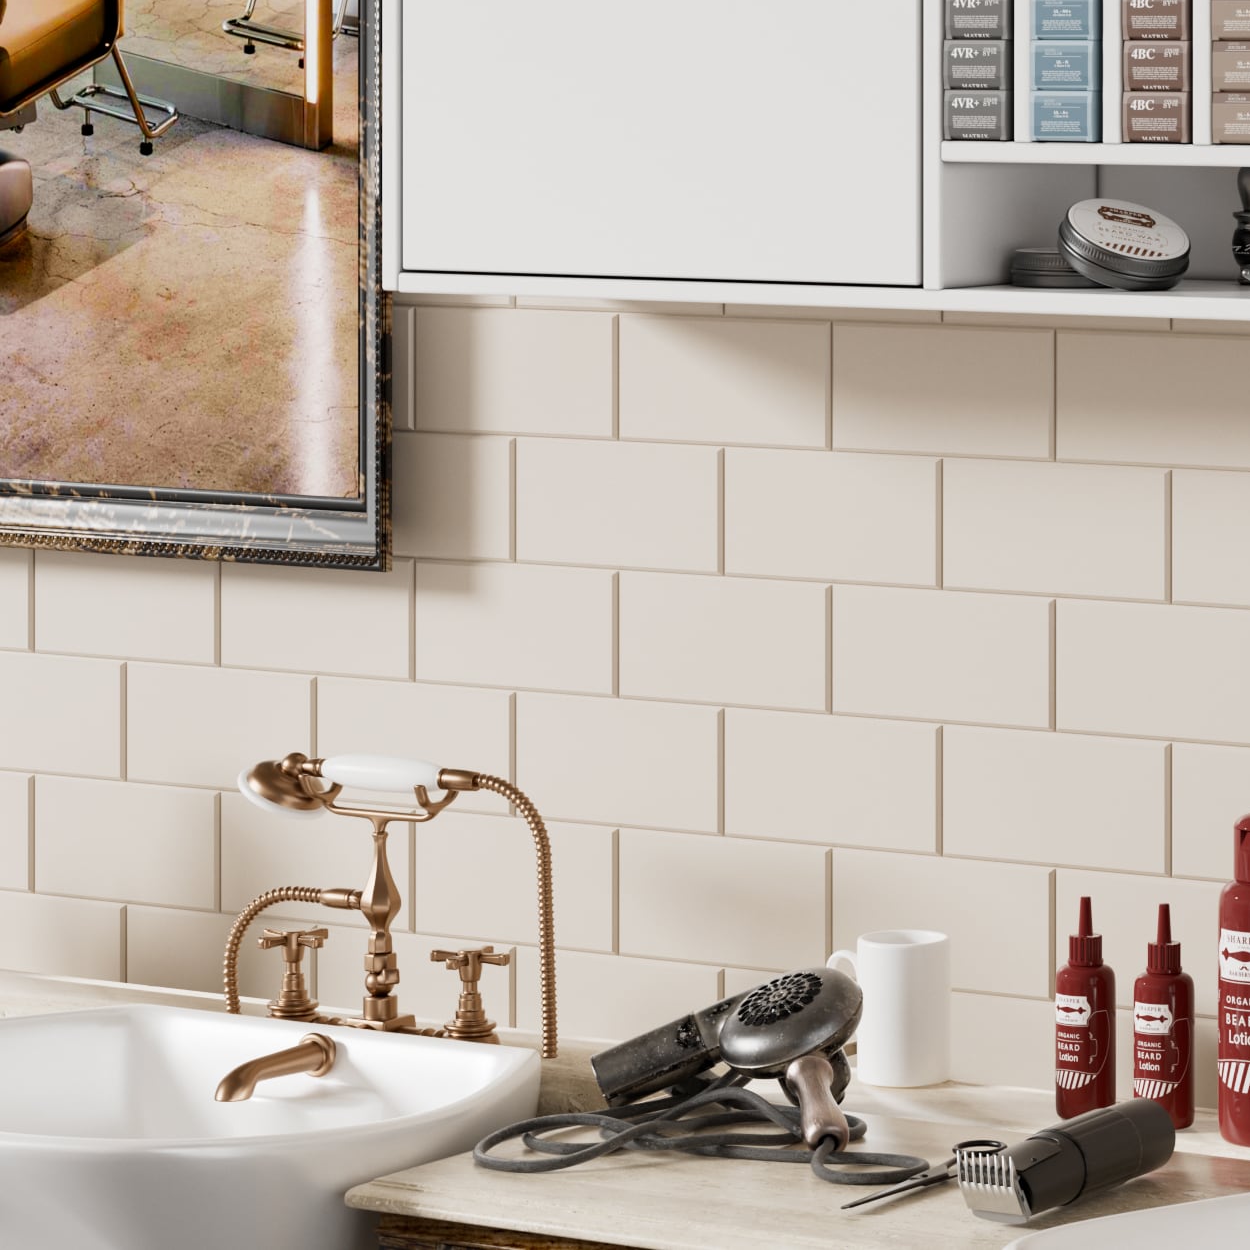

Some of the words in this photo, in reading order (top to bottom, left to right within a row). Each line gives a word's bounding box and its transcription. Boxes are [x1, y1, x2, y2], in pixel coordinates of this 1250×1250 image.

[951, 47, 979, 59] 4VR+
[1131, 48, 1155, 60] 4BC
[951, 97, 980, 109] 4VR+
[1130, 99, 1155, 111] 4BC
[1058, 1031, 1080, 1039] ORGANIC
[1058, 1042, 1080, 1051] BEARD
[1138, 1040, 1162, 1048] ORGANIC
[1059, 1051, 1078, 1062] Lotion
[1137, 1051, 1162, 1061] BEARD
[1139, 1061, 1160, 1072] Lotion
